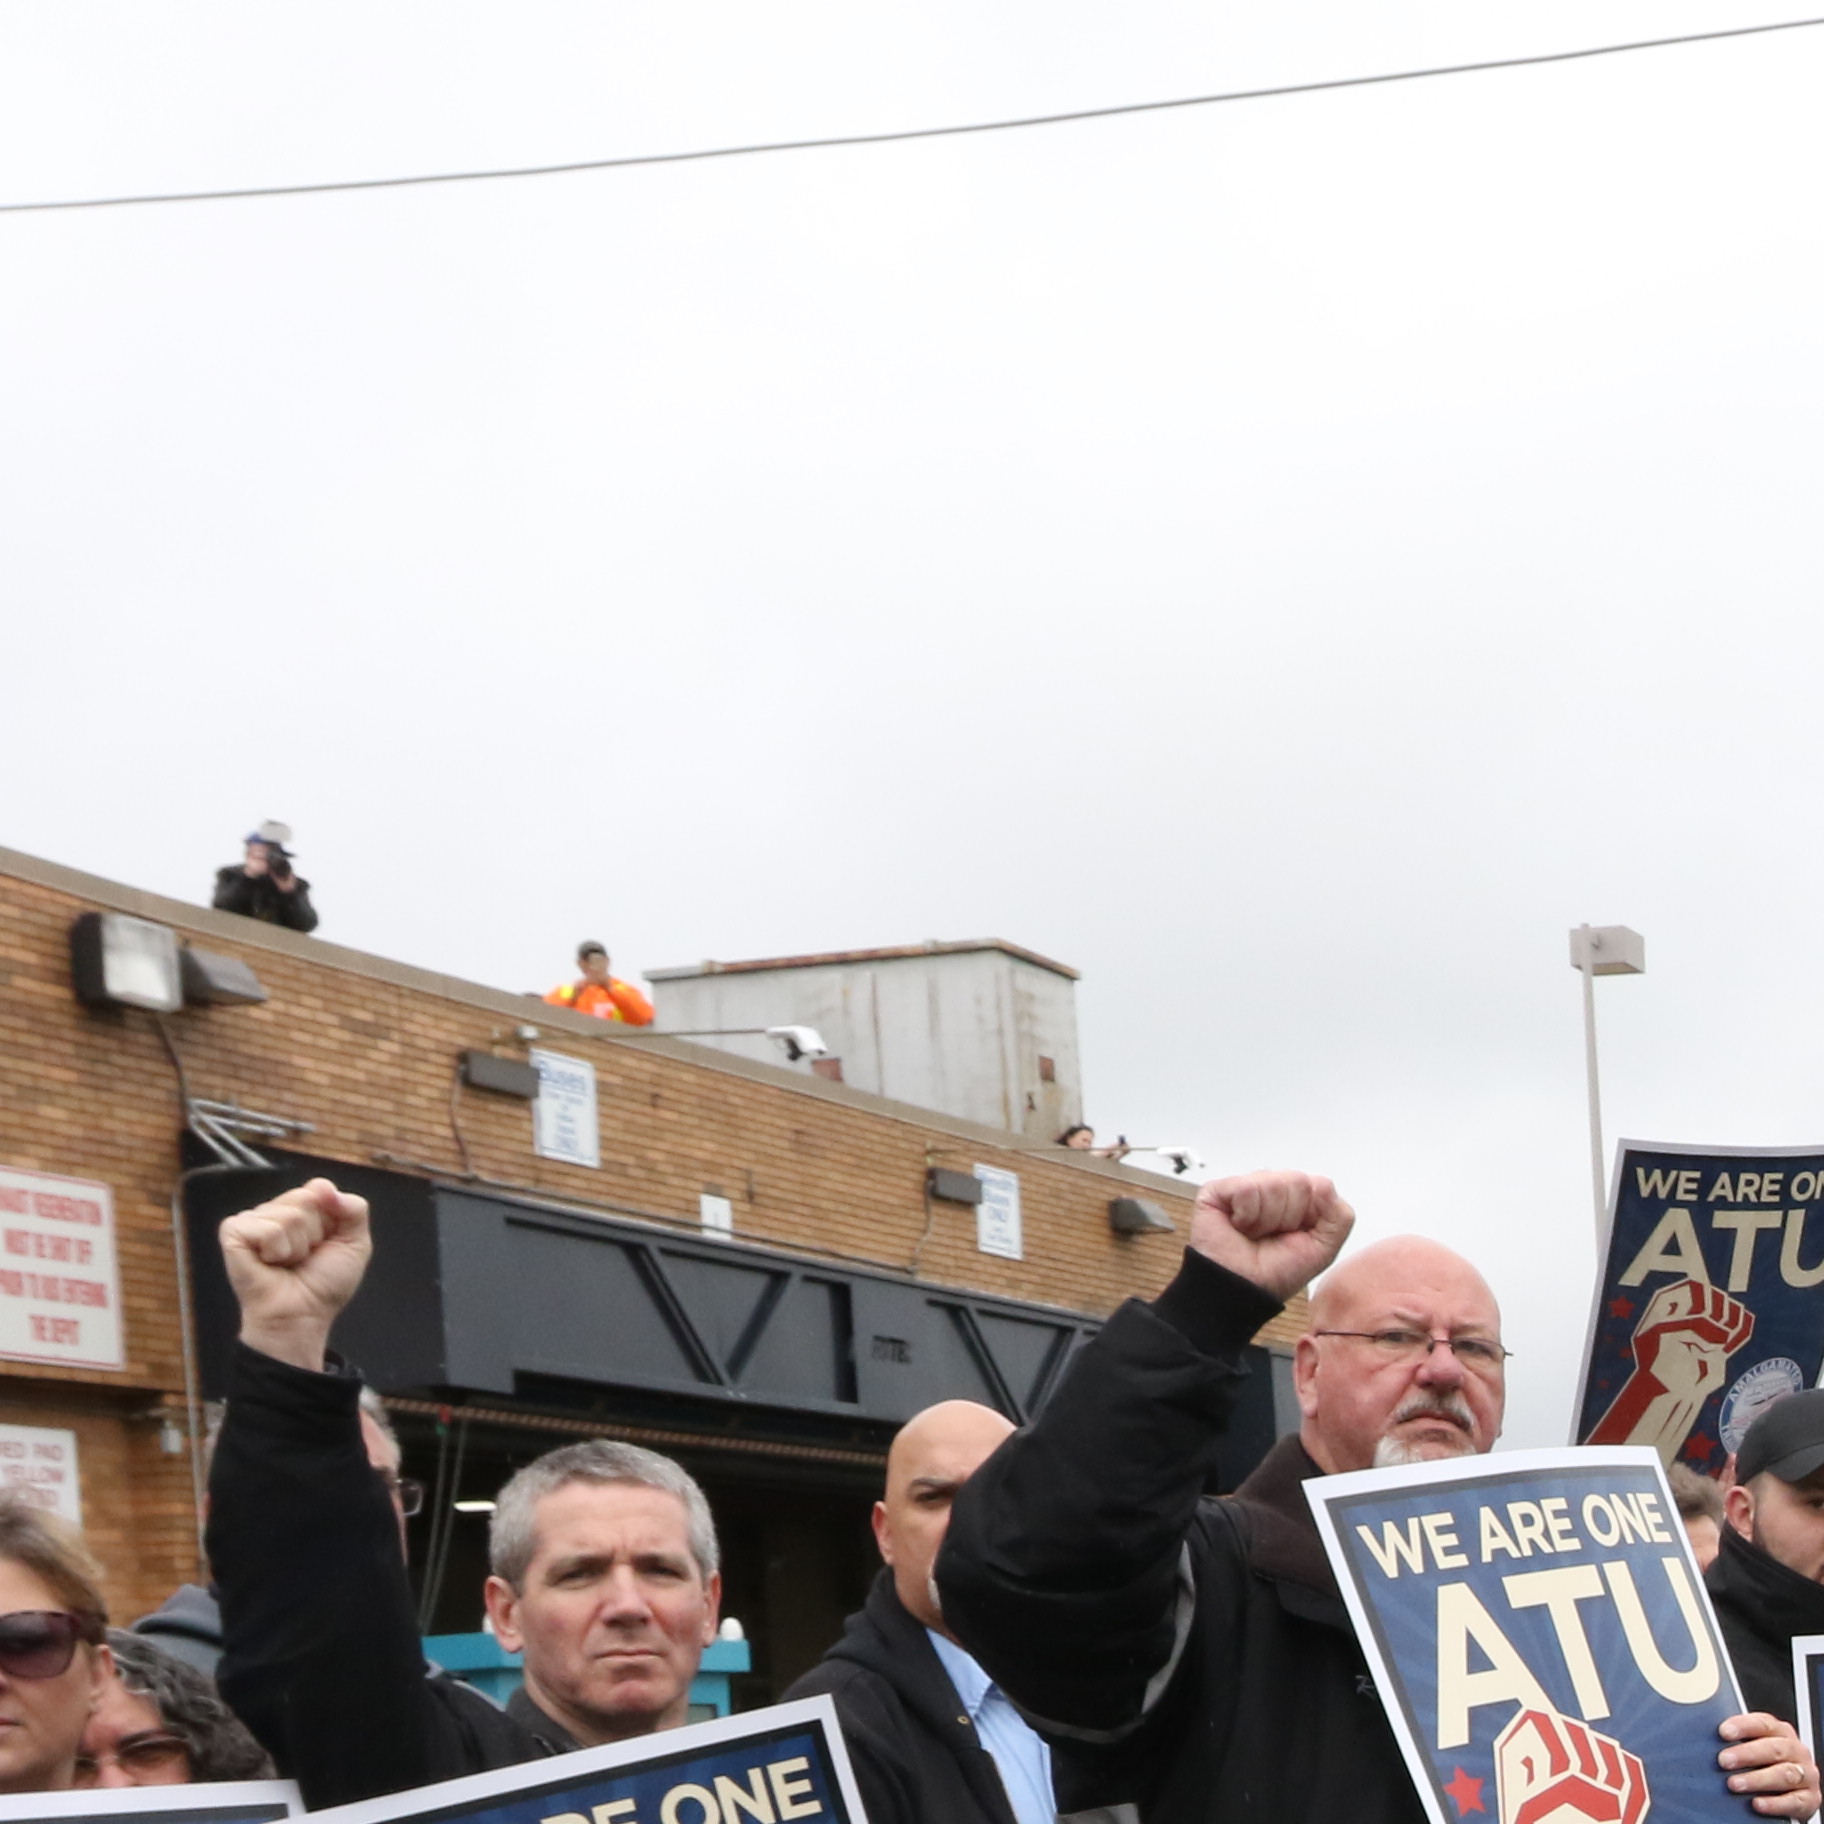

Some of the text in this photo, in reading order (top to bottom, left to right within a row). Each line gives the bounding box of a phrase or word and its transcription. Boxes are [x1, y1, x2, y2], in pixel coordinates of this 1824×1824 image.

[1635, 1167, 1701, 1200] WE
[1707, 1171, 1784, 1203] ARE
[1357, 1493, 1673, 1579] WE ARE ONE
[1436, 1557, 1720, 1750] ATU
